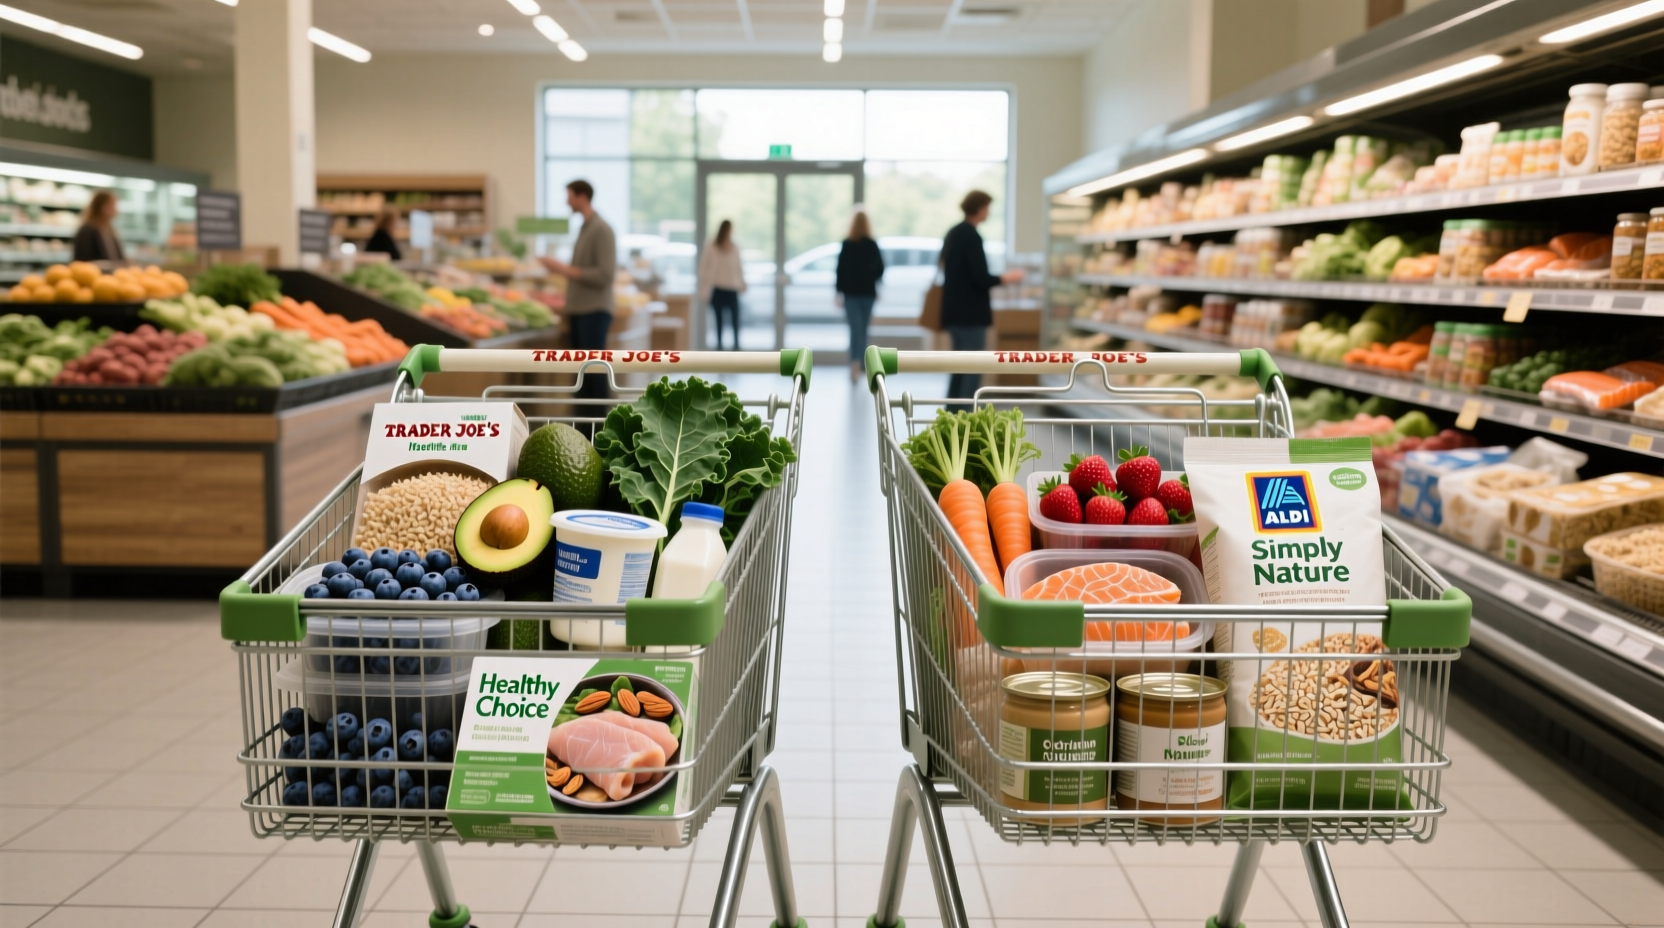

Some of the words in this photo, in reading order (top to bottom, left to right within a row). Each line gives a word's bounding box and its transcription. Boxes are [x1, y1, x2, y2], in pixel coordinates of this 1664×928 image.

[532, 350, 614, 362] TRADER
[622, 351, 681, 363] JOE'S
[994, 352, 1074, 363] TRADER
[385, 423, 451, 438] TRADER
[455, 421, 500, 438] JOE'S
[1265, 509, 1310, 525] ALDI
[1251, 536, 1343, 562] Simply
[1253, 562, 1350, 586] Nature
[479, 673, 560, 701] Healthy
[476, 695, 549, 718] Choice
